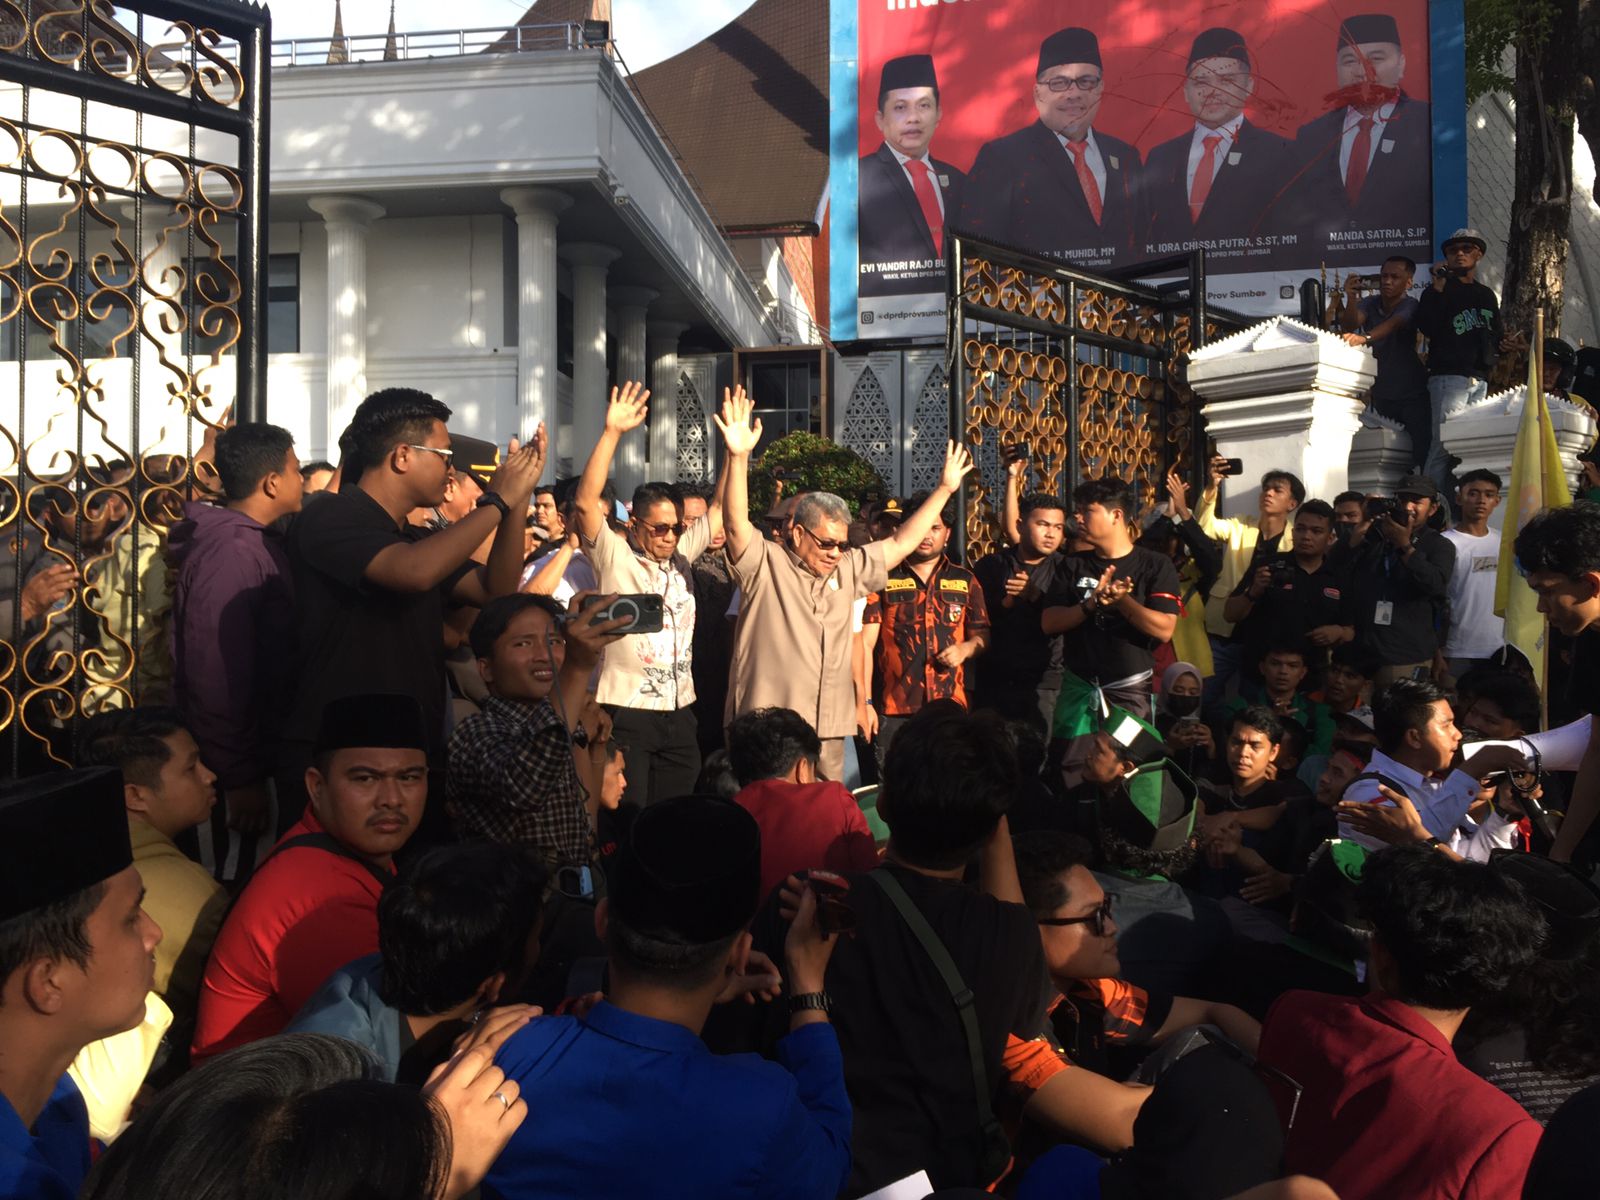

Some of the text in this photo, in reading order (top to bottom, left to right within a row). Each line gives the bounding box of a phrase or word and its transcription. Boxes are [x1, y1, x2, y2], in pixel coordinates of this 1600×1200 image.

[1281, 235, 1297, 244] MM
[1330, 227, 1426, 241] NANDA SATRIA, S.IP
[1065, 248, 1099, 259] MUHIDI,
[1101, 247, 1115, 256] MM
[860, 259, 946, 273] EVI YANDRI RAJO BU
[1207, 291, 1227, 300] Prov
